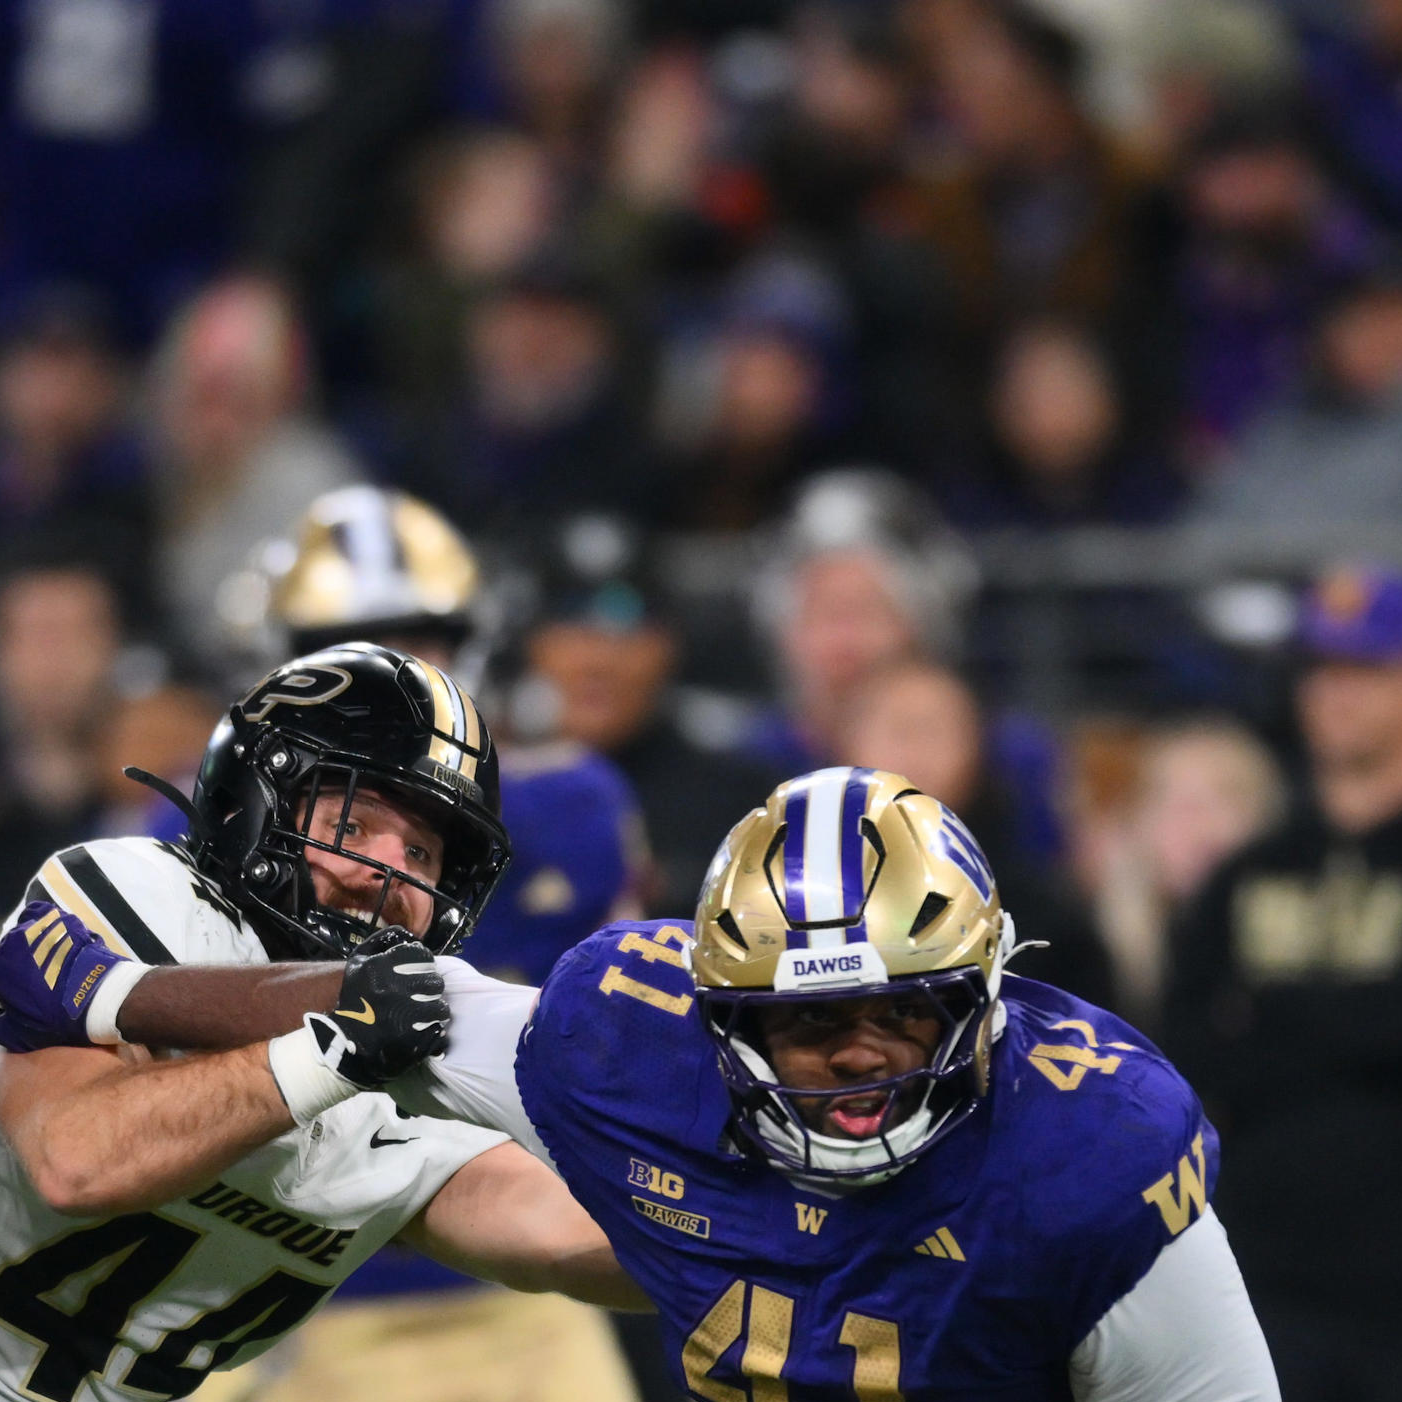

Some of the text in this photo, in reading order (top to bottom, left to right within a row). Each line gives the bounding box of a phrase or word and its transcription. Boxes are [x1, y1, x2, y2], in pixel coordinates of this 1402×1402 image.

[235, 664, 353, 722] P
[73, 963, 106, 1008] ADIZERO
[599, 925, 697, 1016] 41
[793, 955, 862, 976] DAWGS
[628, 1158, 684, 1200] B1G
[1141, 1131, 1206, 1236] W
[187, 1181, 356, 1266] URDUE
[643, 1203, 699, 1233] DAWGS
[795, 1202, 828, 1235] W
